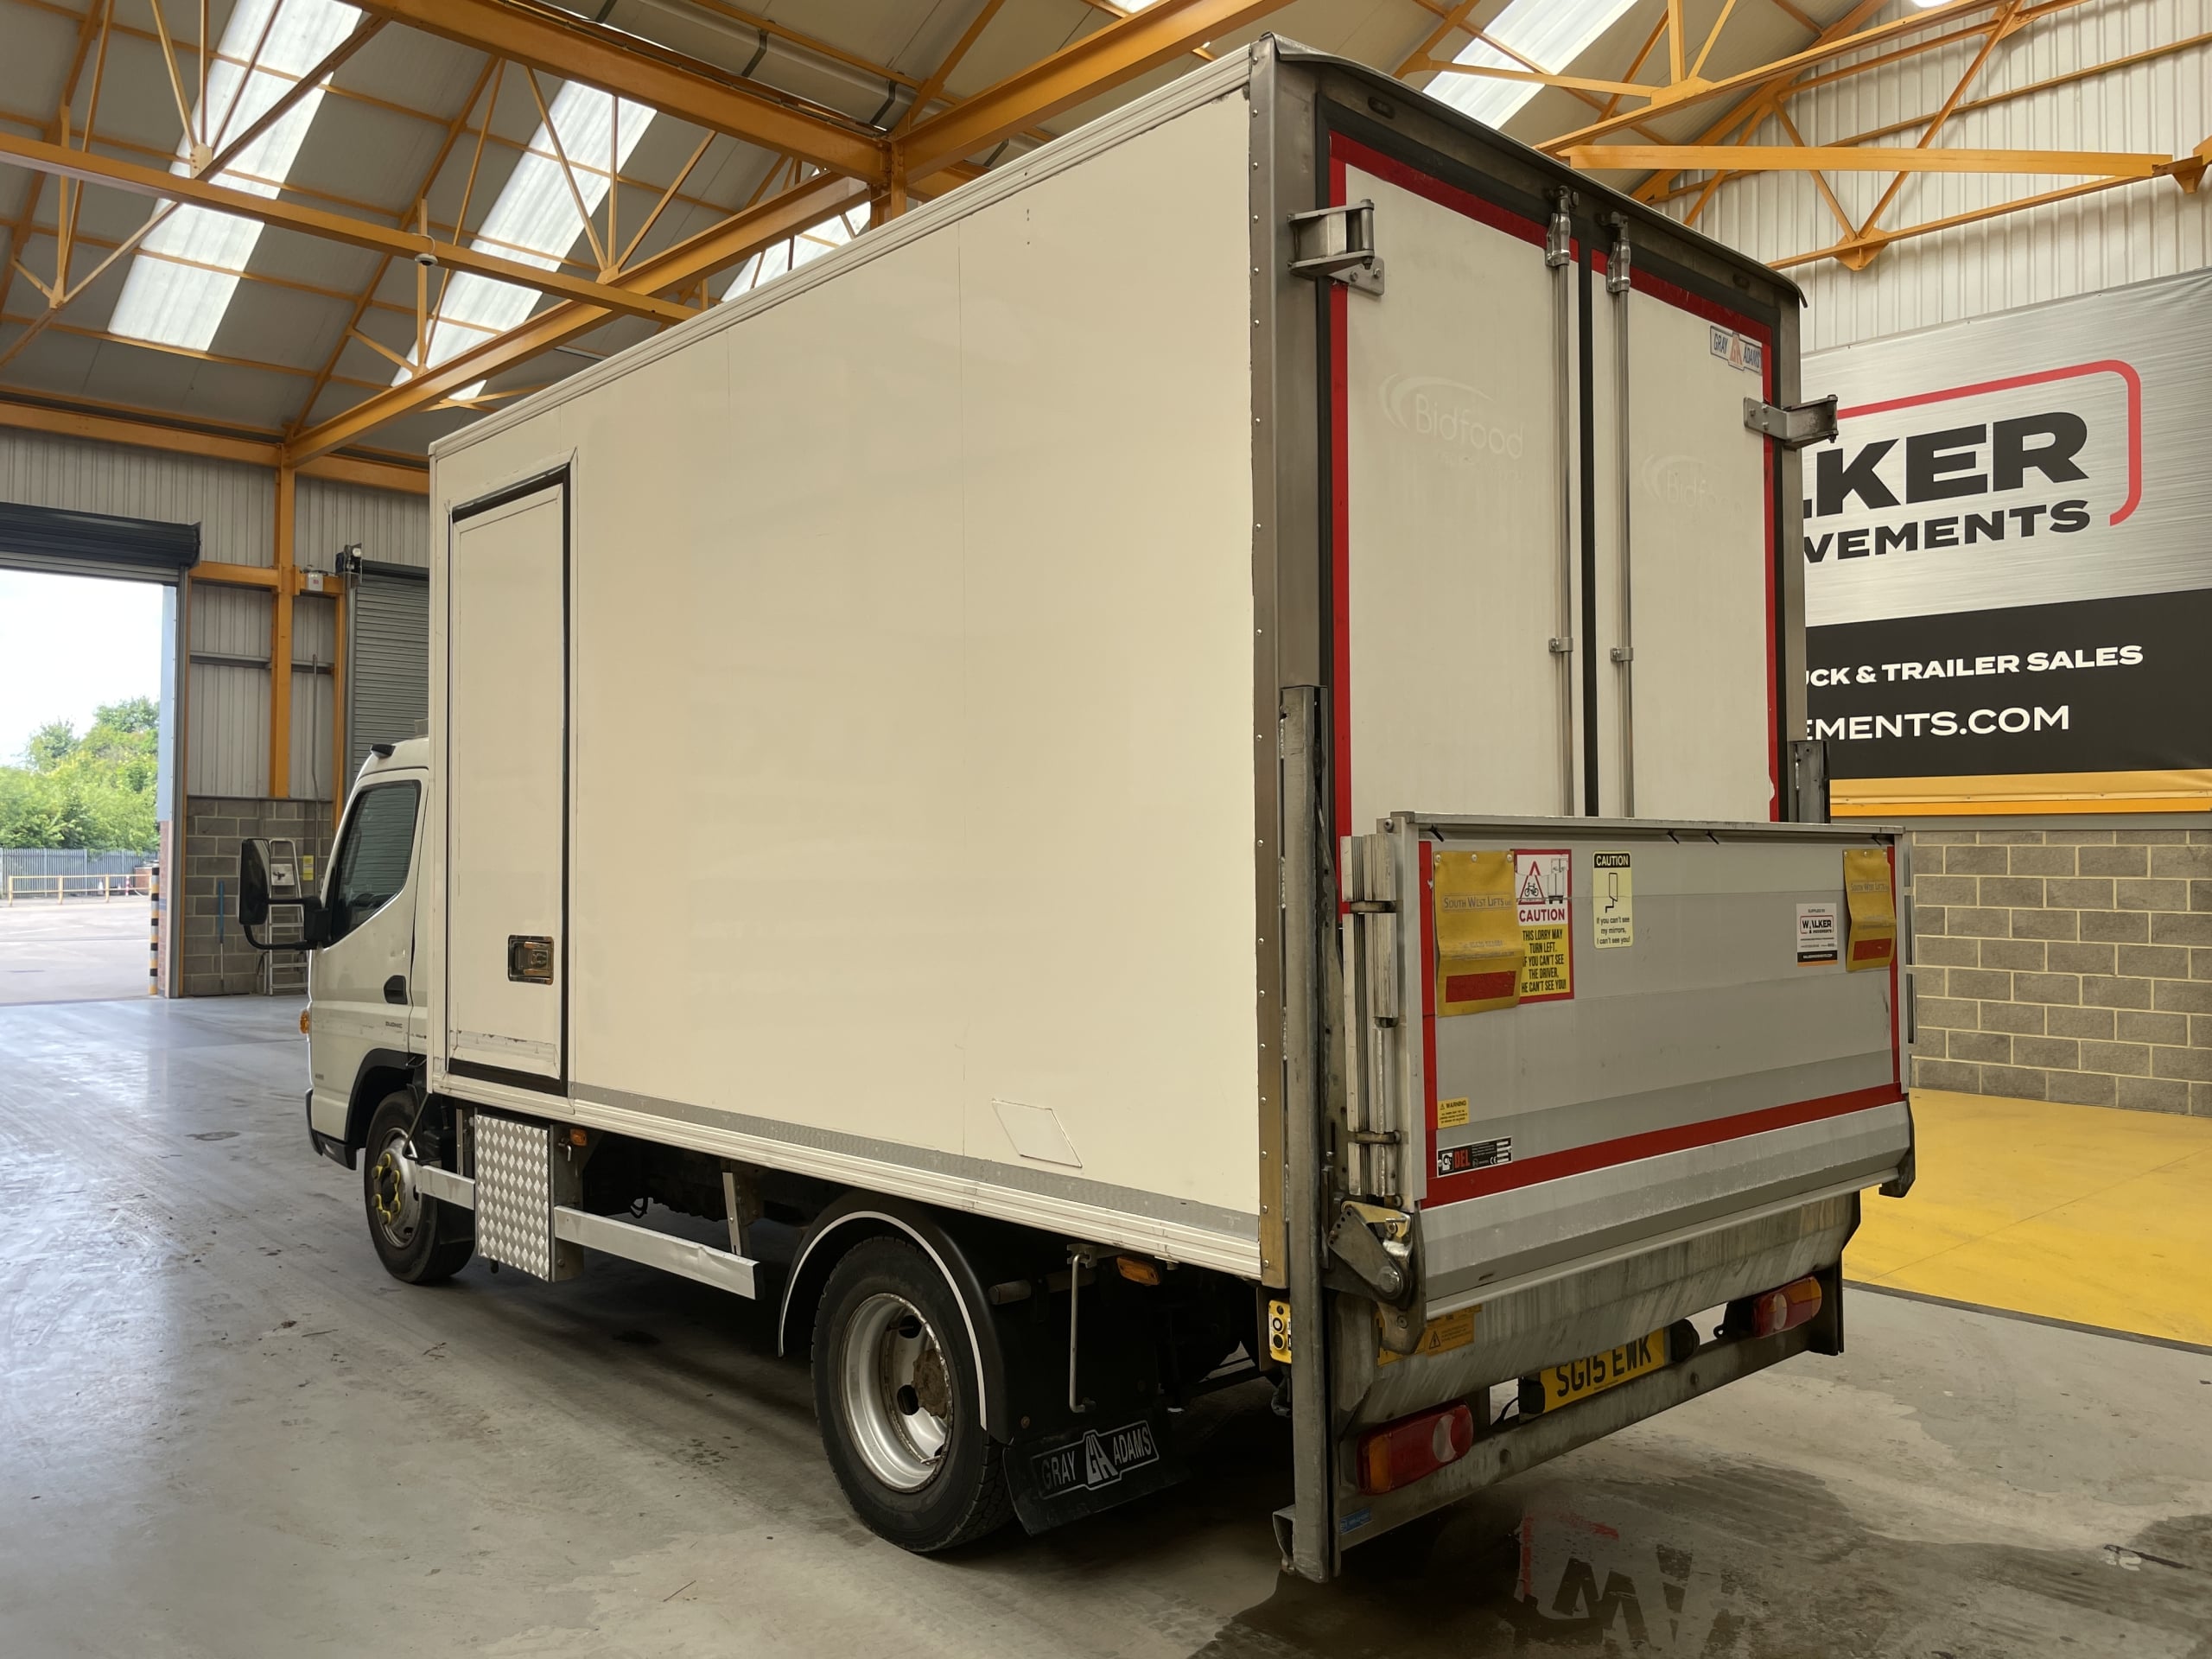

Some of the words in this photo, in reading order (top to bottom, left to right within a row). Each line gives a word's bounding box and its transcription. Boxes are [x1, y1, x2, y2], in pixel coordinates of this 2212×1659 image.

[1714, 334, 1728, 354] GRAY
[1743, 346, 1760, 368] ADAMS
[1415, 393, 1524, 461] Bidfood
[1803, 411, 2089, 518] KER
[1806, 667, 1851, 687] CK
[1855, 665, 1877, 683] &
[1881, 654, 2020, 682] TRAILER
[2026, 645, 2144, 671] SALES
[1807, 705, 2069, 741] MENTS.COM
[1596, 855, 1629, 866] CAUTION
[1444, 897, 1466, 908] SOUTH
[1467, 896, 1486, 908] WEST
[1487, 895, 1503, 906] LIFTS
[1519, 909, 1565, 922] CAUTION
[1522, 931, 1535, 941] THIS
[1535, 929, 1551, 940] LORRY
[1552, 929, 1562, 939] MAY
[1529, 943, 1542, 953] TURN
[1529, 955, 1539, 967] YOU
[1539, 954, 1554, 966] CAN'T
[1555, 954, 1565, 964] SEE
[1529, 969, 1538, 980] THE
[1522, 982, 1529, 993] HE
[1529, 981, 1544, 992] CAN'T
[1545, 980, 1554, 990] SEE
[1454, 1149, 1471, 1168] DEL
[1556, 1355, 1605, 1397] SG15
[1611, 1334, 1651, 1376] EWK
[1042, 1450, 1076, 1490] GRAY
[1113, 1427, 1152, 1466] ADAMS
